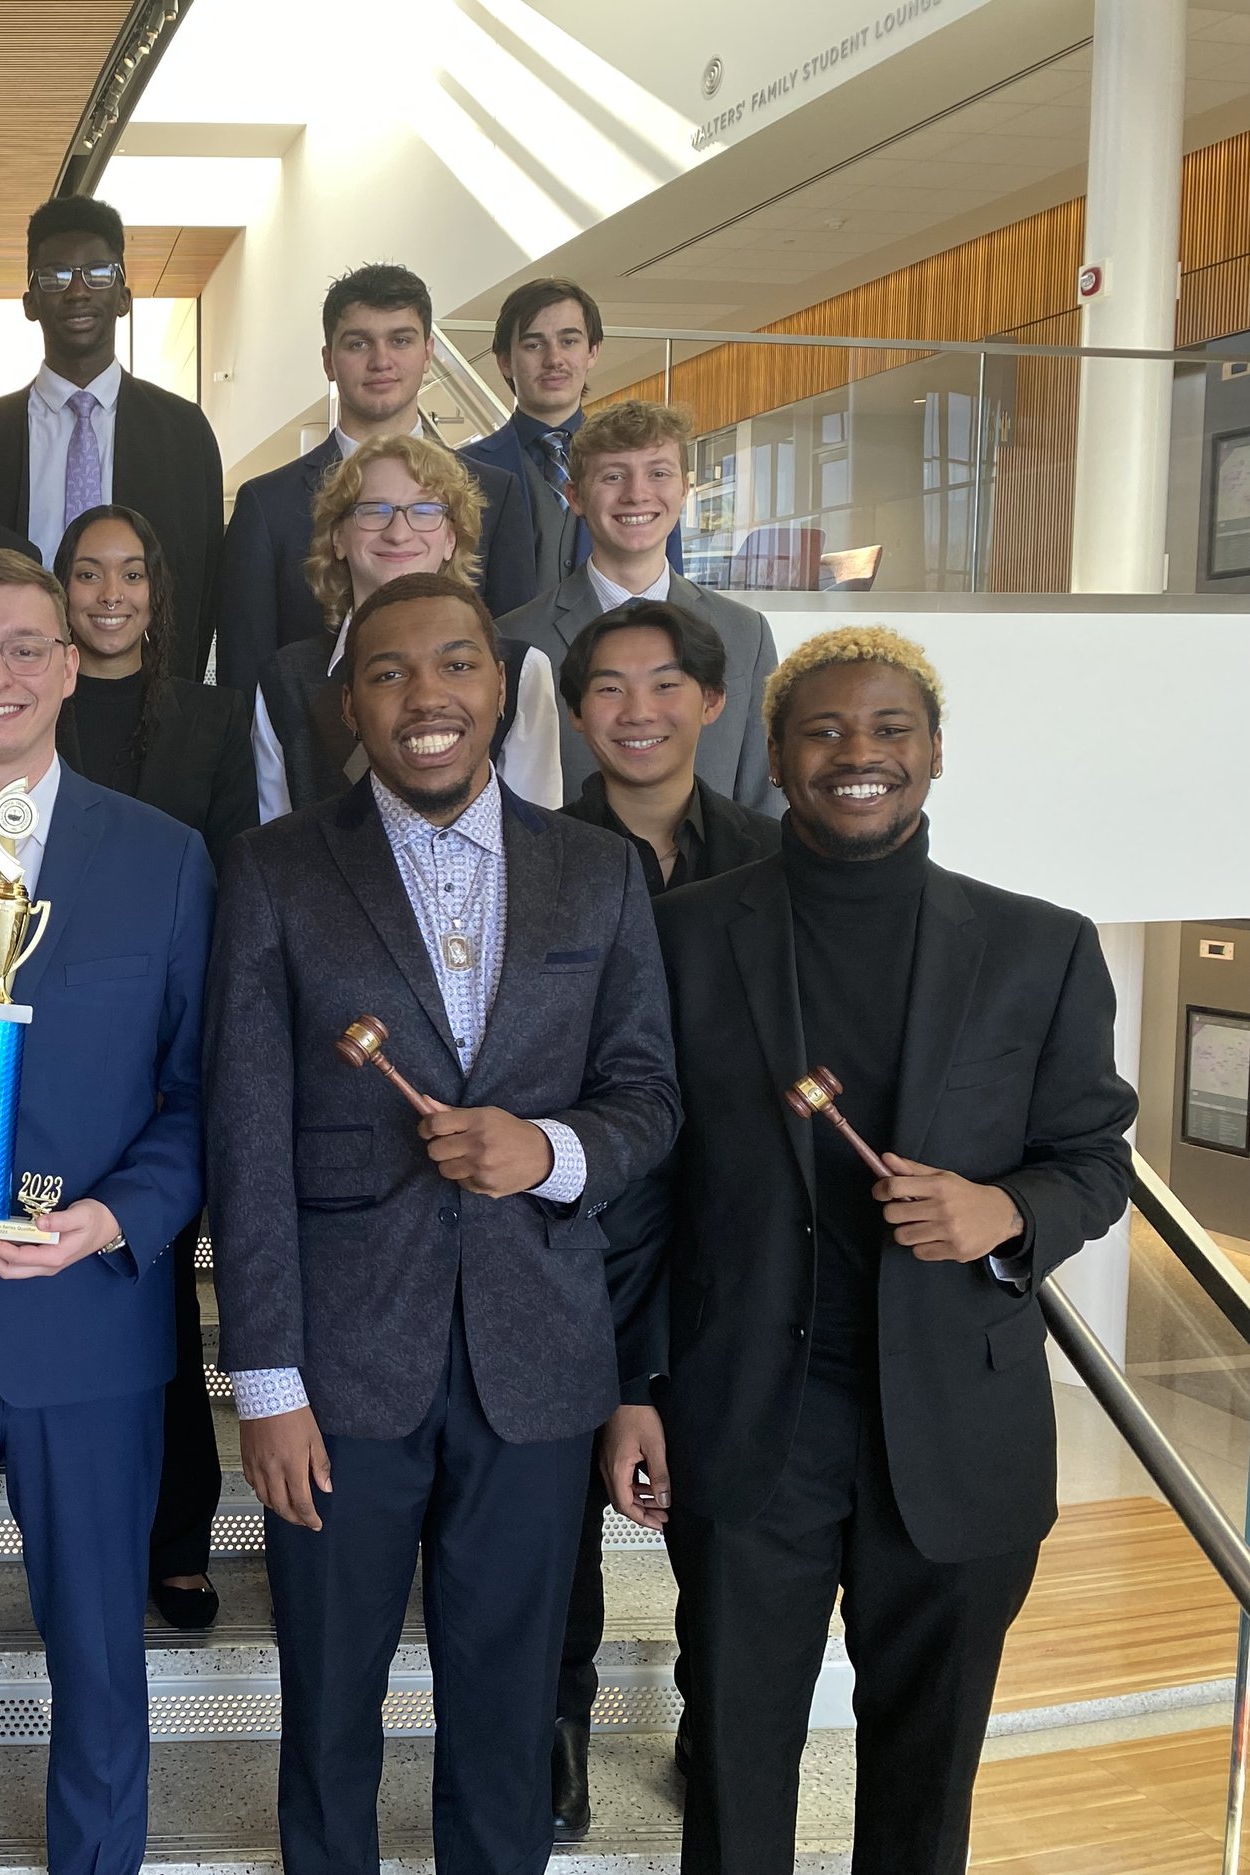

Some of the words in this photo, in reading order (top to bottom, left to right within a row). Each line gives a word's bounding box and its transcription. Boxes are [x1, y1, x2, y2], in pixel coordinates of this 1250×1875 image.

[751, 69, 798, 112] FAMILY
[802, 26, 869, 81] STUDENT
[875, 0, 942, 39] LOUNG
[19, 1171, 63, 1200] 2023
